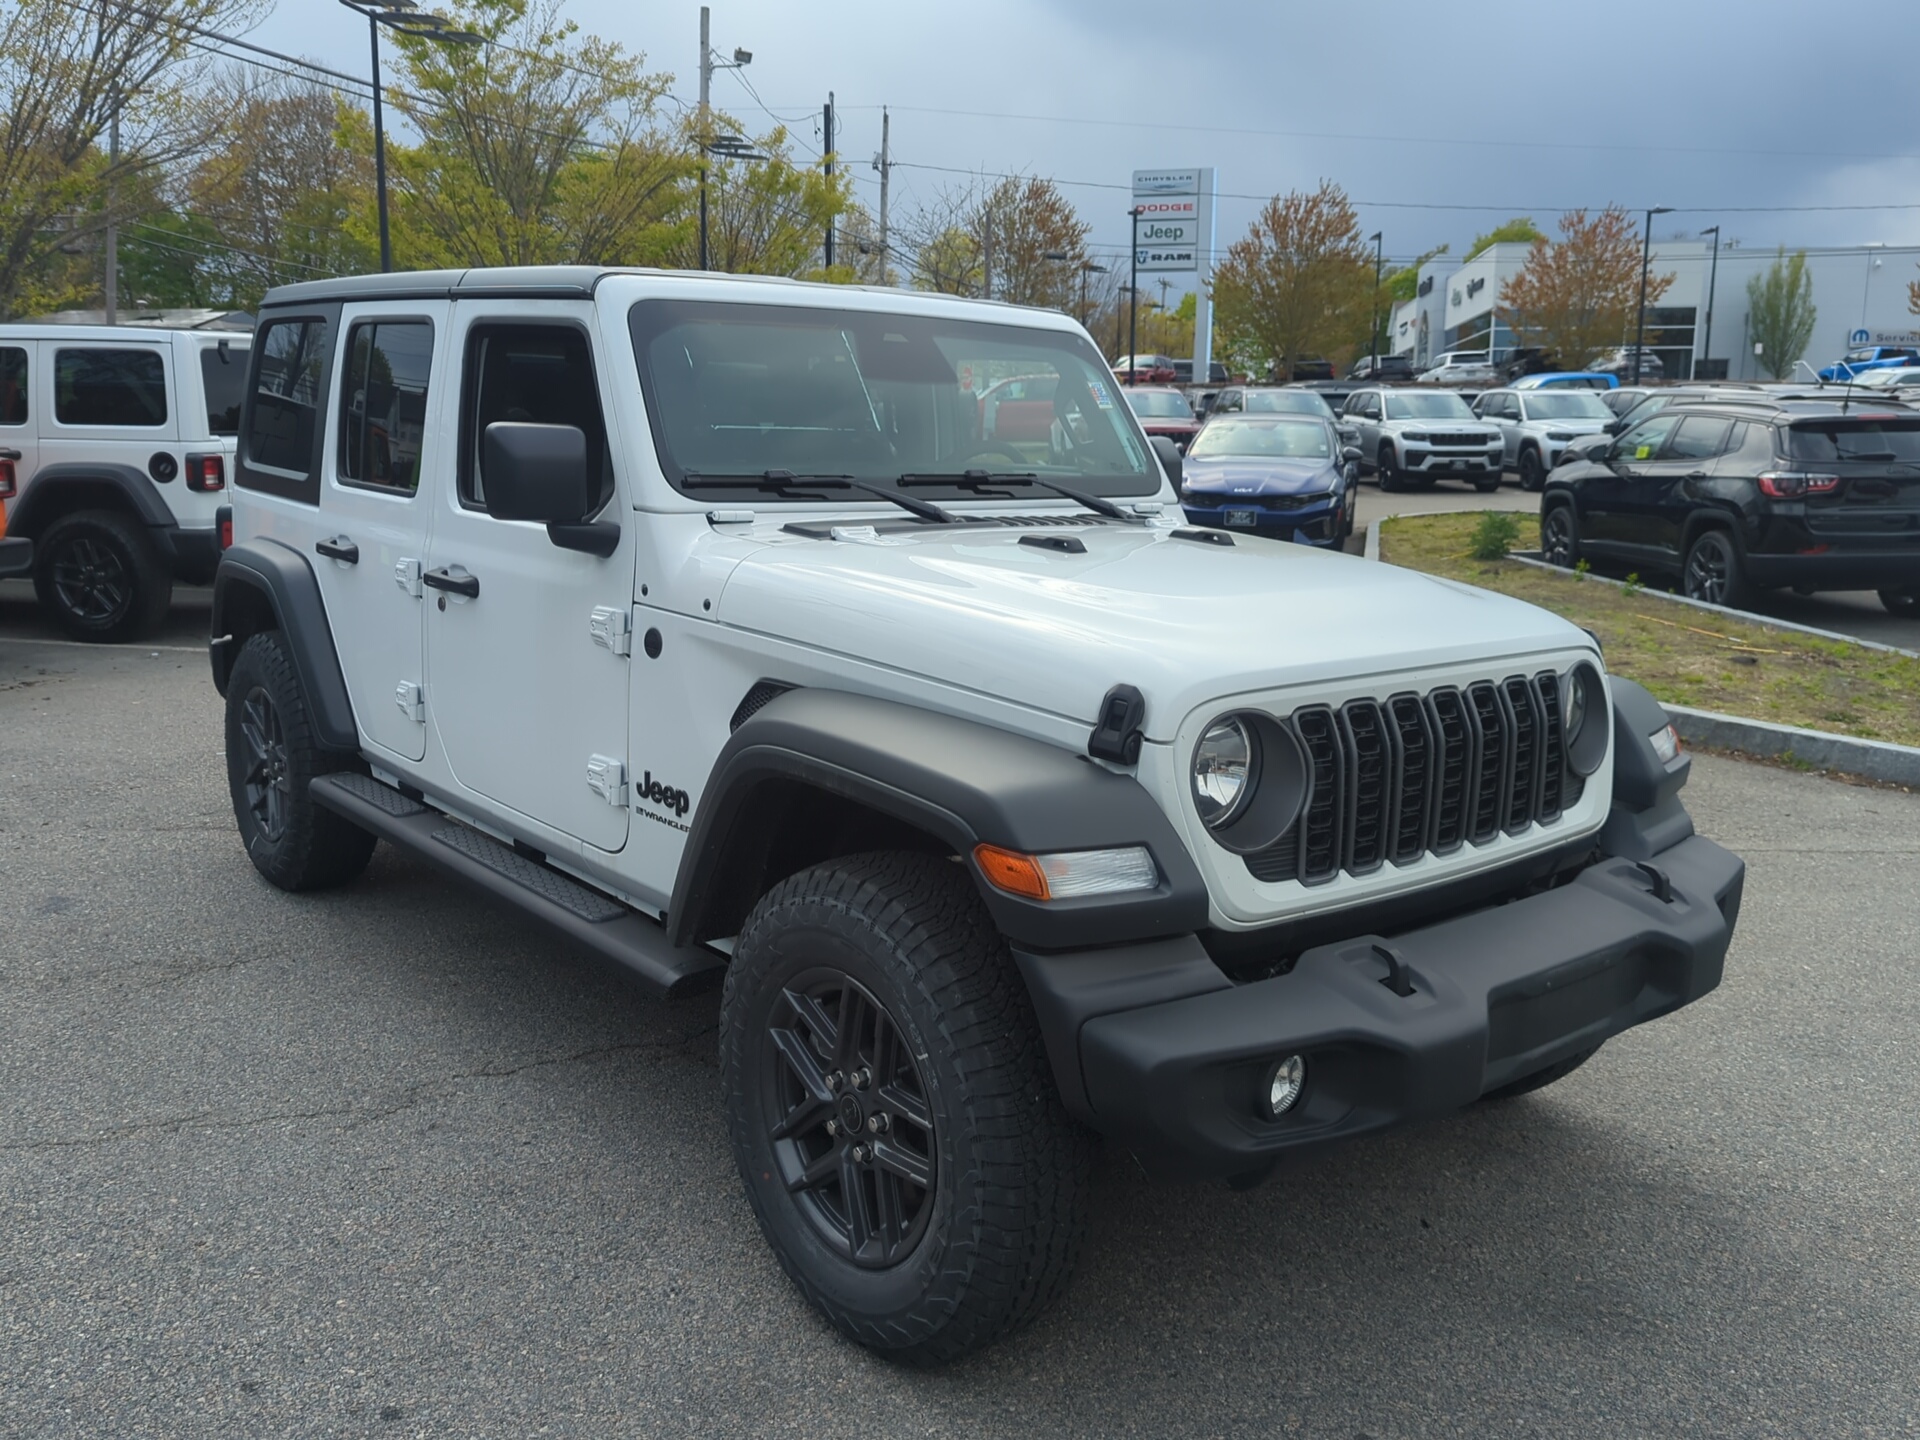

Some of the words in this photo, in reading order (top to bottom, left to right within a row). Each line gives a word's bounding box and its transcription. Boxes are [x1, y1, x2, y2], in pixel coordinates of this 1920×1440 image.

[1136, 203, 1193, 212] DODGE
[1143, 224, 1183, 241] Jeep
[1151, 253, 1191, 261] RAM
[636, 769, 690, 818] Jeep
